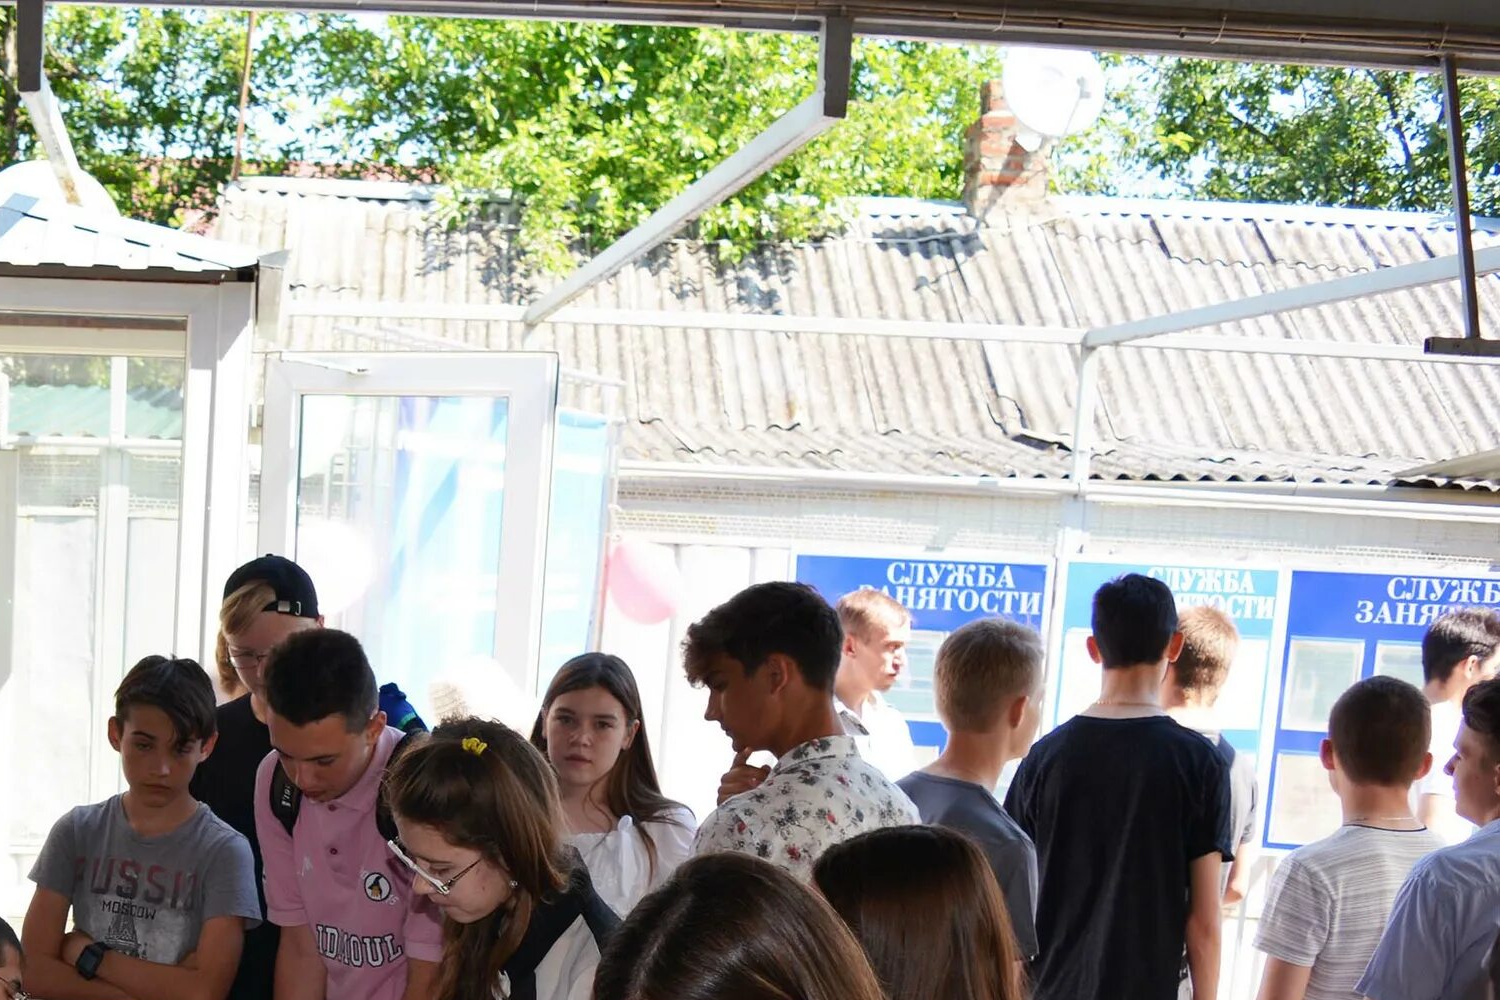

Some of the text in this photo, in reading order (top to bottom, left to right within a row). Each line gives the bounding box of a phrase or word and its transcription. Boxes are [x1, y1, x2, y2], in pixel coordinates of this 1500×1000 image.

[887, 561, 1015, 589] СЛУЖБА
[1147, 567, 1255, 594] СЛУЖБА
[859, 584, 1043, 615] НЯТОСТИ
[1387, 577, 1500, 604] СЛУЖБ
[102, 900, 157, 920] MOSCOW
